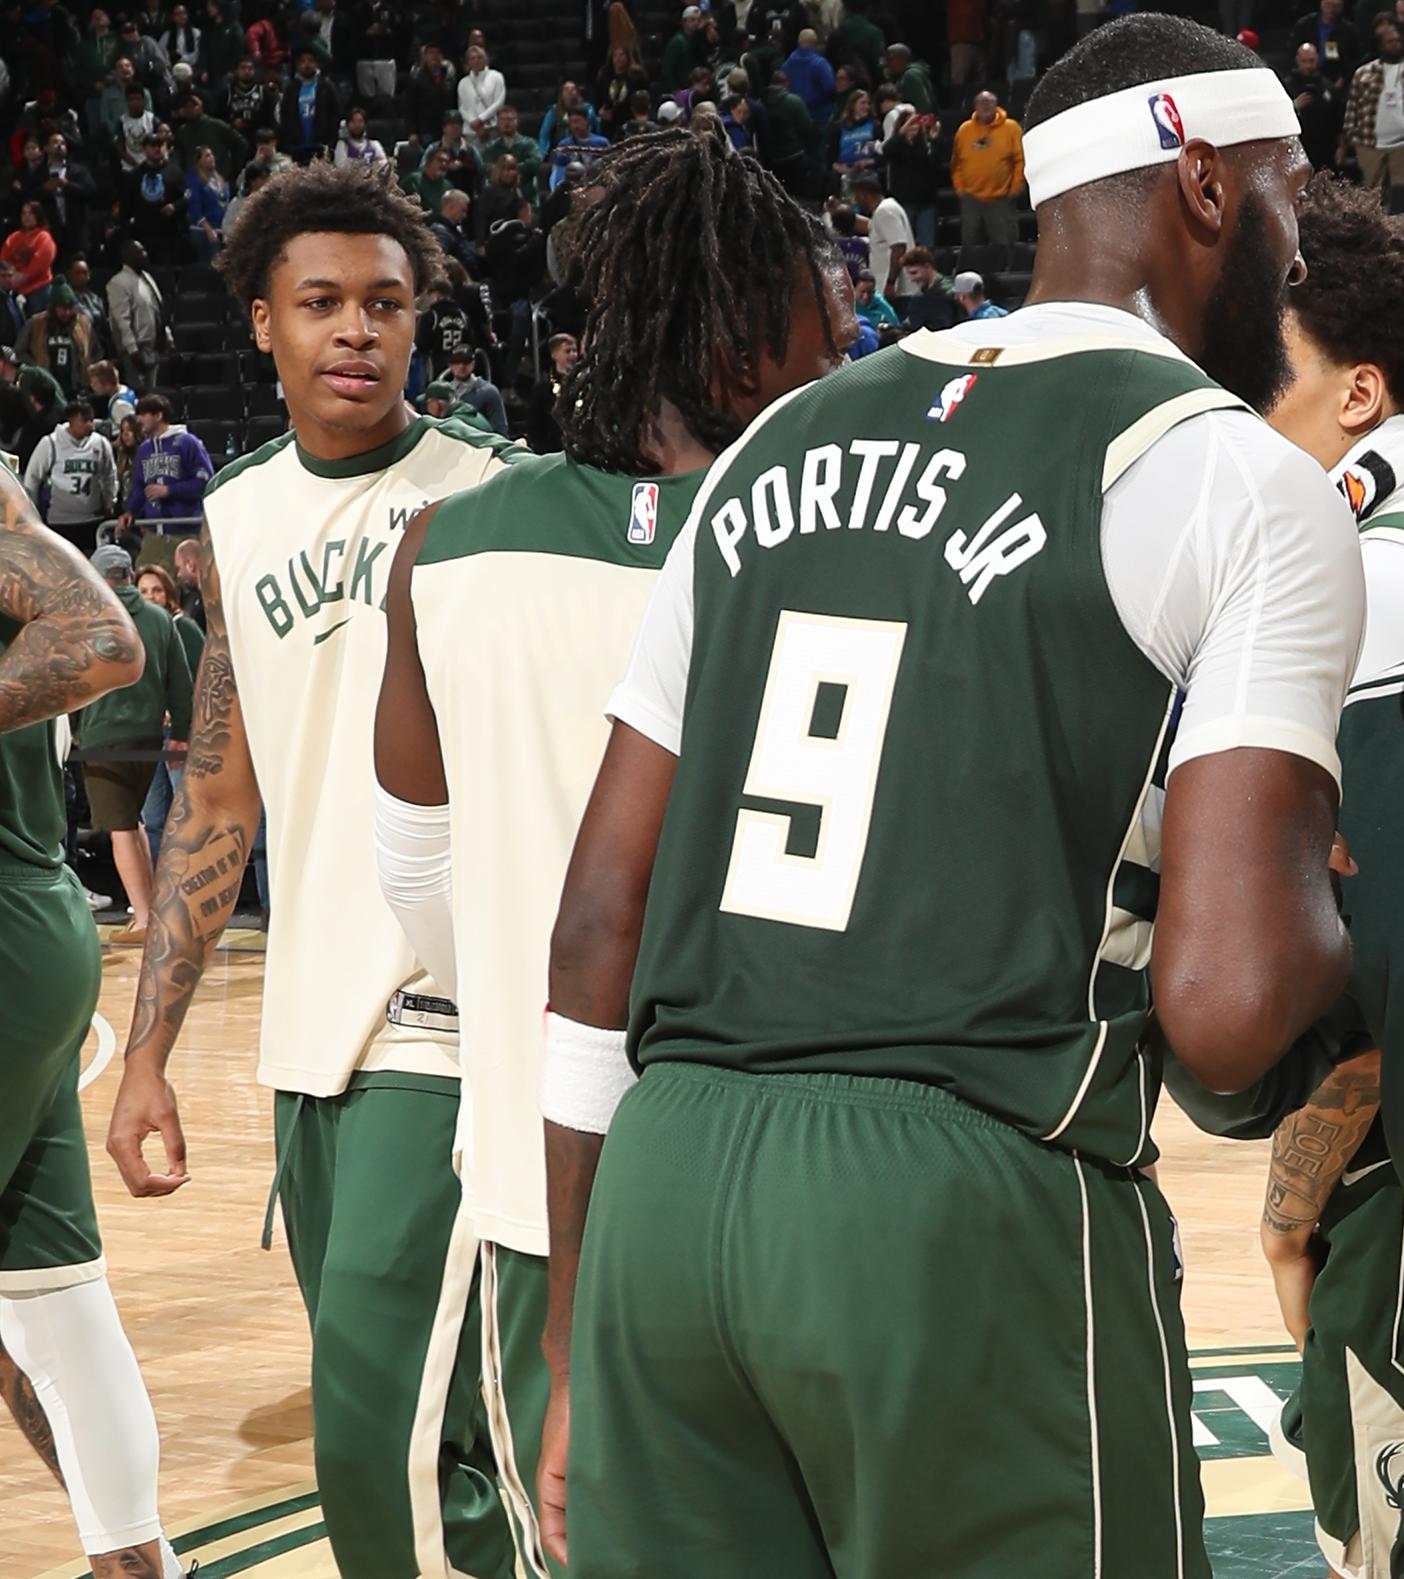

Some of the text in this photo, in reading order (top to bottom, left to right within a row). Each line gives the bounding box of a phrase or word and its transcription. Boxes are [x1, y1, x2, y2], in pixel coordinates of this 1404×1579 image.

[64, 459, 98, 474] BUCKS
[70, 476, 91, 495] 34
[711, 439, 1047, 605] PORTIS JR
[255, 536, 388, 639] BUCK
[719, 609, 908, 932] 9
[1283, 1114, 1342, 1178] FOE
